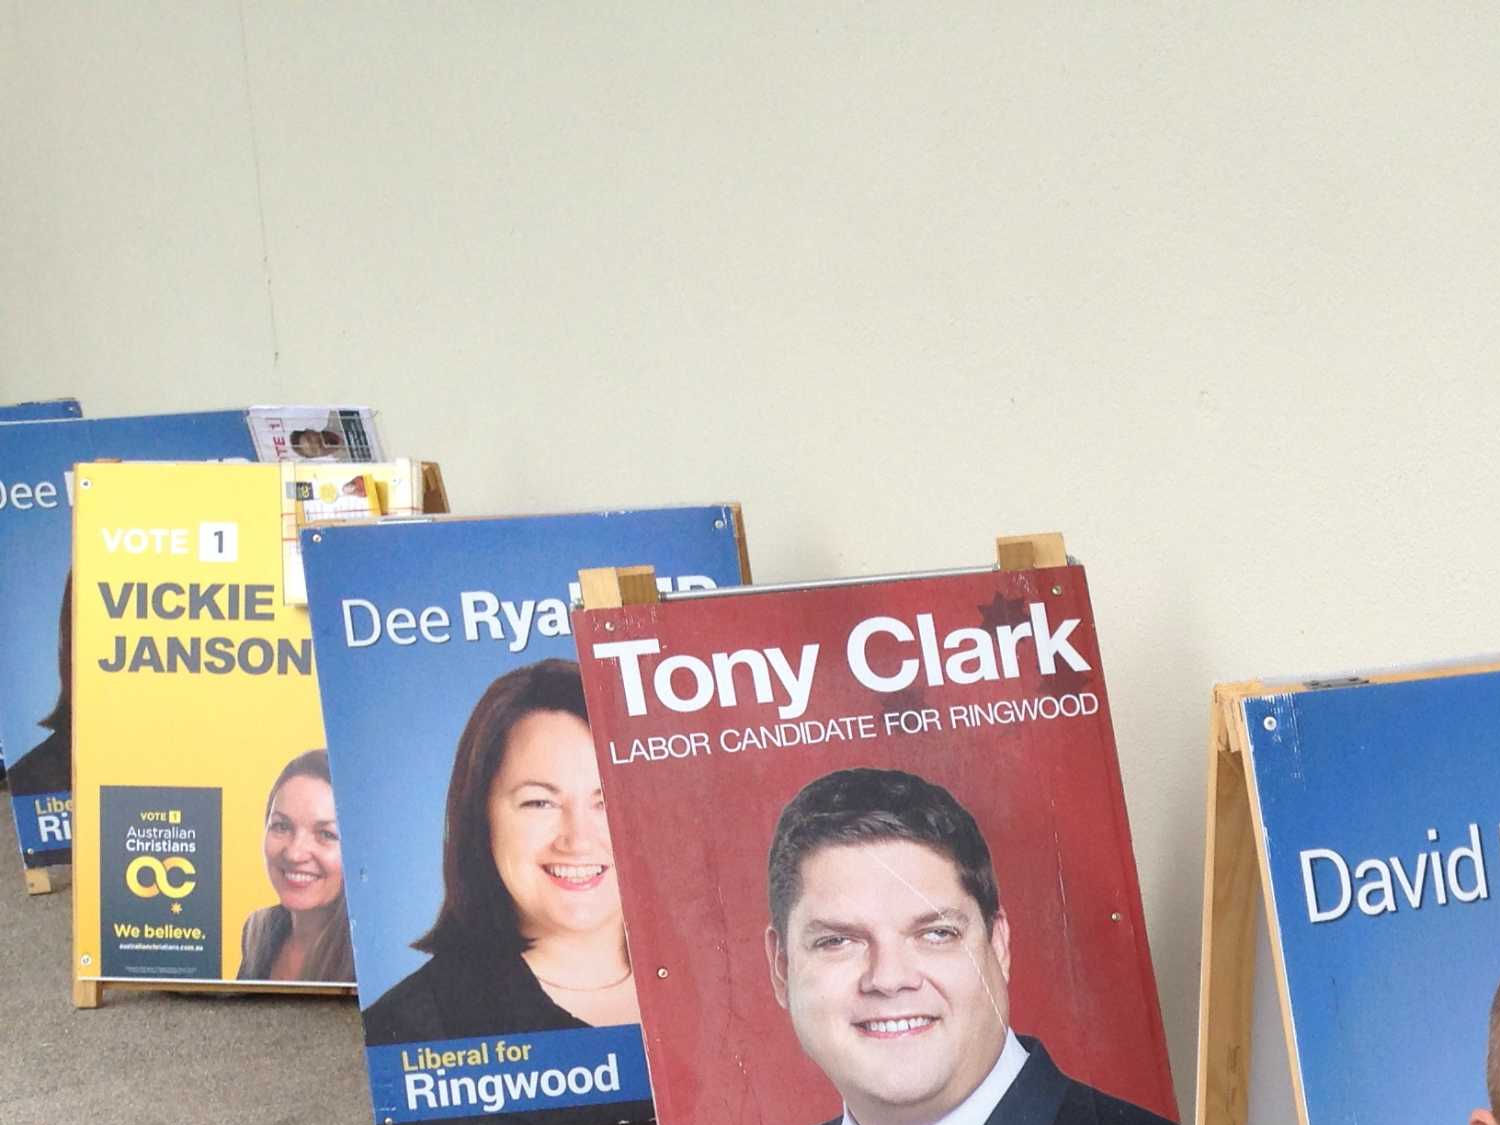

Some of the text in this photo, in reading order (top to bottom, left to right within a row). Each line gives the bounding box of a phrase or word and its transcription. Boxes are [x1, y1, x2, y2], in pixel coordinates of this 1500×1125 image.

[101, 527, 225, 554] VOTE 1
[97, 582, 275, 620] VICKIE
[342, 599, 450, 648] Dee
[97, 636, 312, 676] JANSON
[594, 602, 1091, 719] Tony Clark
[610, 692, 1099, 764] LABOR CANDIDATE FOR RINGWOOD
[127, 826, 196, 840] Australian
[140, 812, 167, 822] VOTE
[126, 840, 196, 853] Christians
[1300, 823, 1488, 923] David
[113, 923, 206, 940] We believe.
[402, 1041, 532, 1072] Liberal for
[404, 1053, 621, 1113] Ringwood
